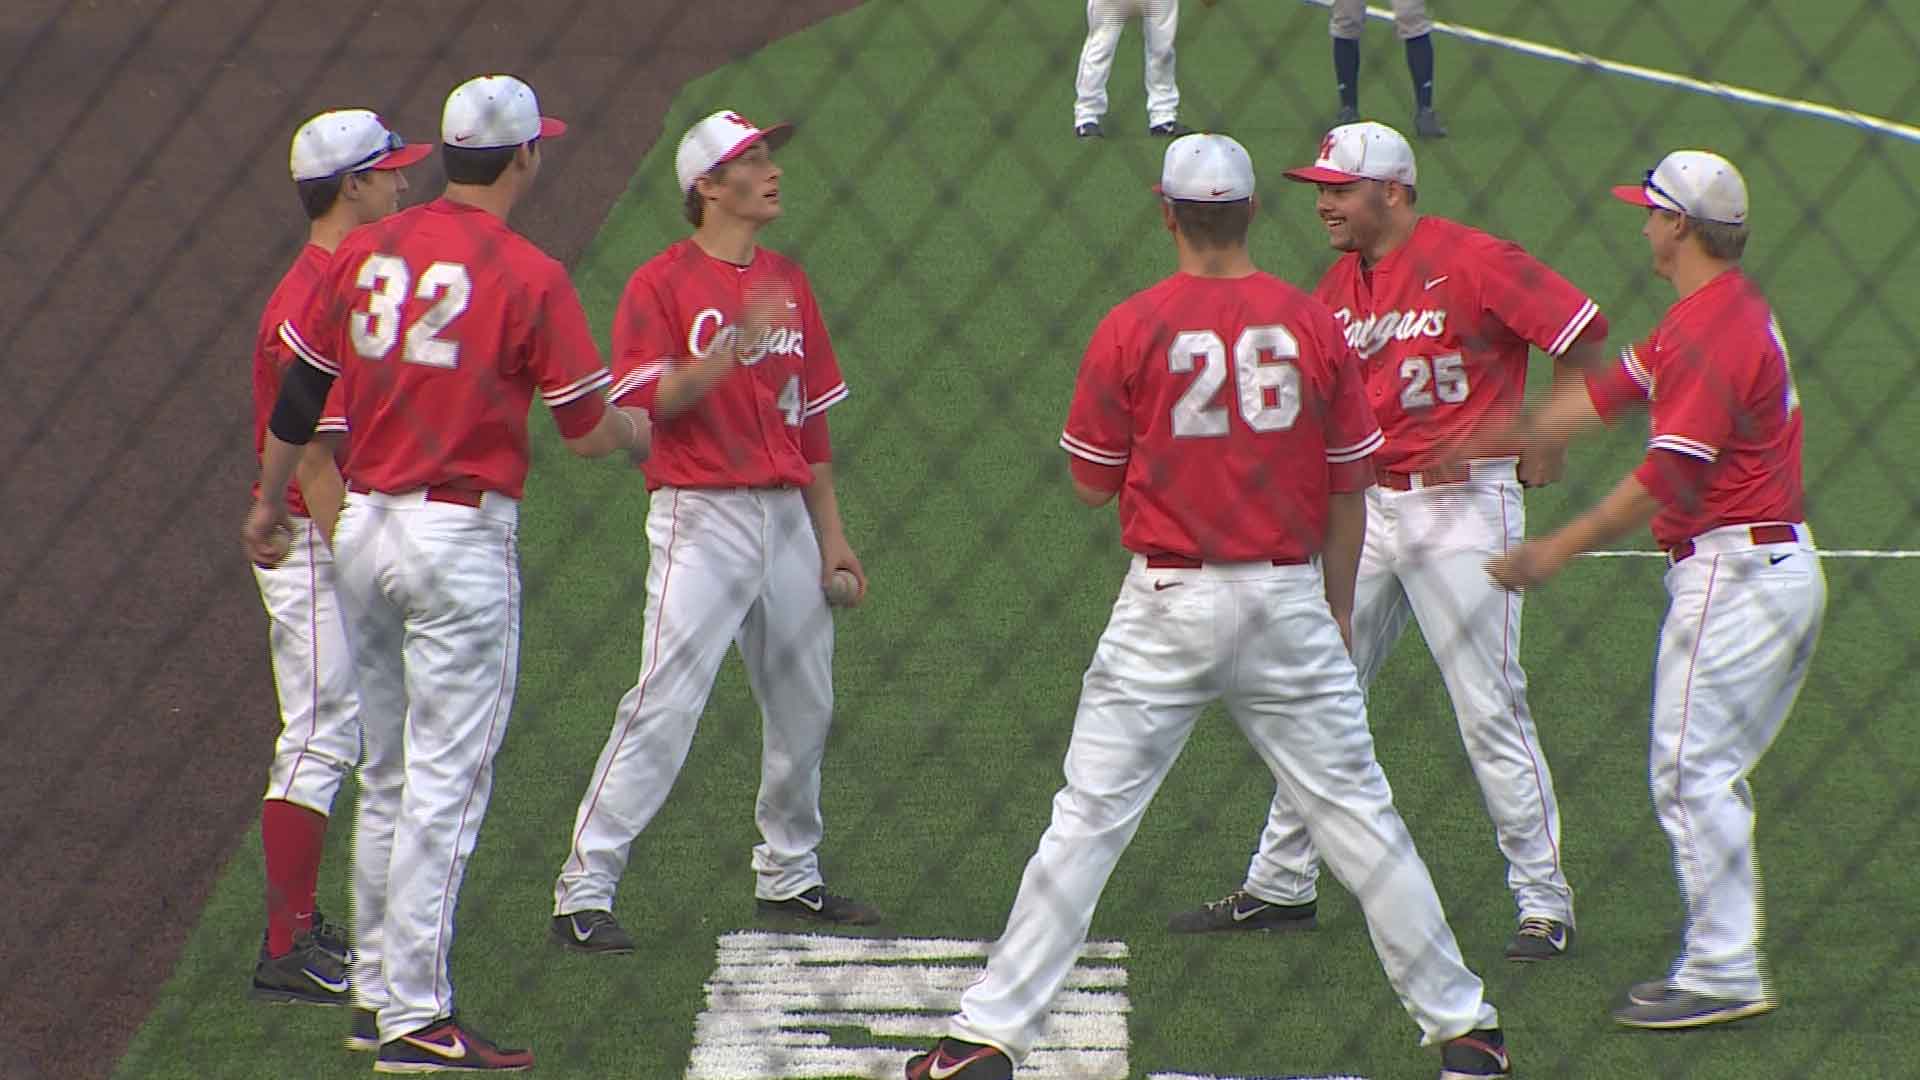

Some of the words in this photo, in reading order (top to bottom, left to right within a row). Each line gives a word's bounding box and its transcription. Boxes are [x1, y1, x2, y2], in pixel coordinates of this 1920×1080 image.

[350, 251, 472, 369] 32
[1168, 324, 1304, 439] 26
[1400, 352, 1470, 409] 25
